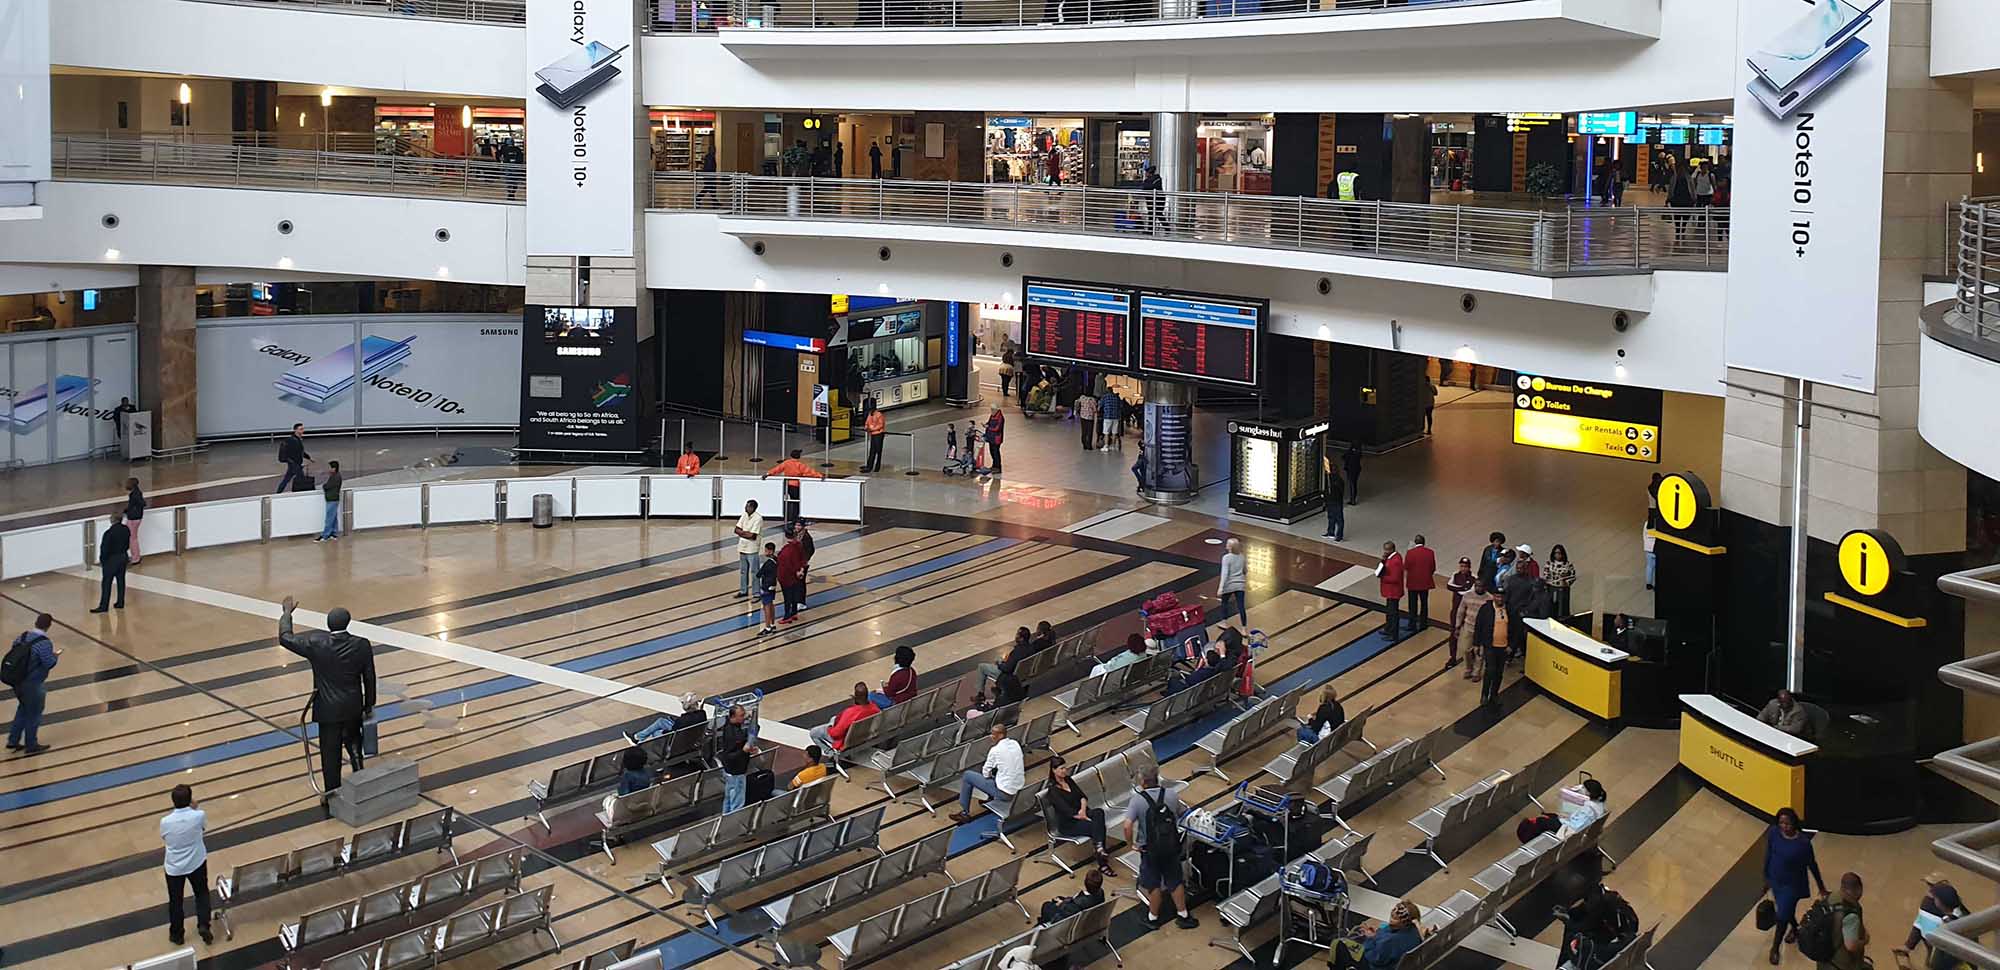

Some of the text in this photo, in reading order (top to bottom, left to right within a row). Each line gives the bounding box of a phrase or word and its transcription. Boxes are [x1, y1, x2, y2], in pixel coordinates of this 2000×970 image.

[570, 0, 586, 46] alaxy
[573, 105, 587, 188] Note10 10+
[1792, 112, 1815, 258] Note10 10+
[480, 328, 519, 336] SAMSUNG
[259, 343, 313, 366] Galaxy
[363, 374, 466, 416] Note10 10+
[1546, 382, 1613, 398] Bureau De Change
[1546, 400, 1571, 410] Toilets
[1239, 425, 1283, 439] sunglass hut
[1594, 426, 1623, 436] Rentals
[1606, 443, 1624, 451] Taxis
[1552, 660, 1569, 675] TAXIS
[1709, 745, 1745, 771] SHUTTLE
